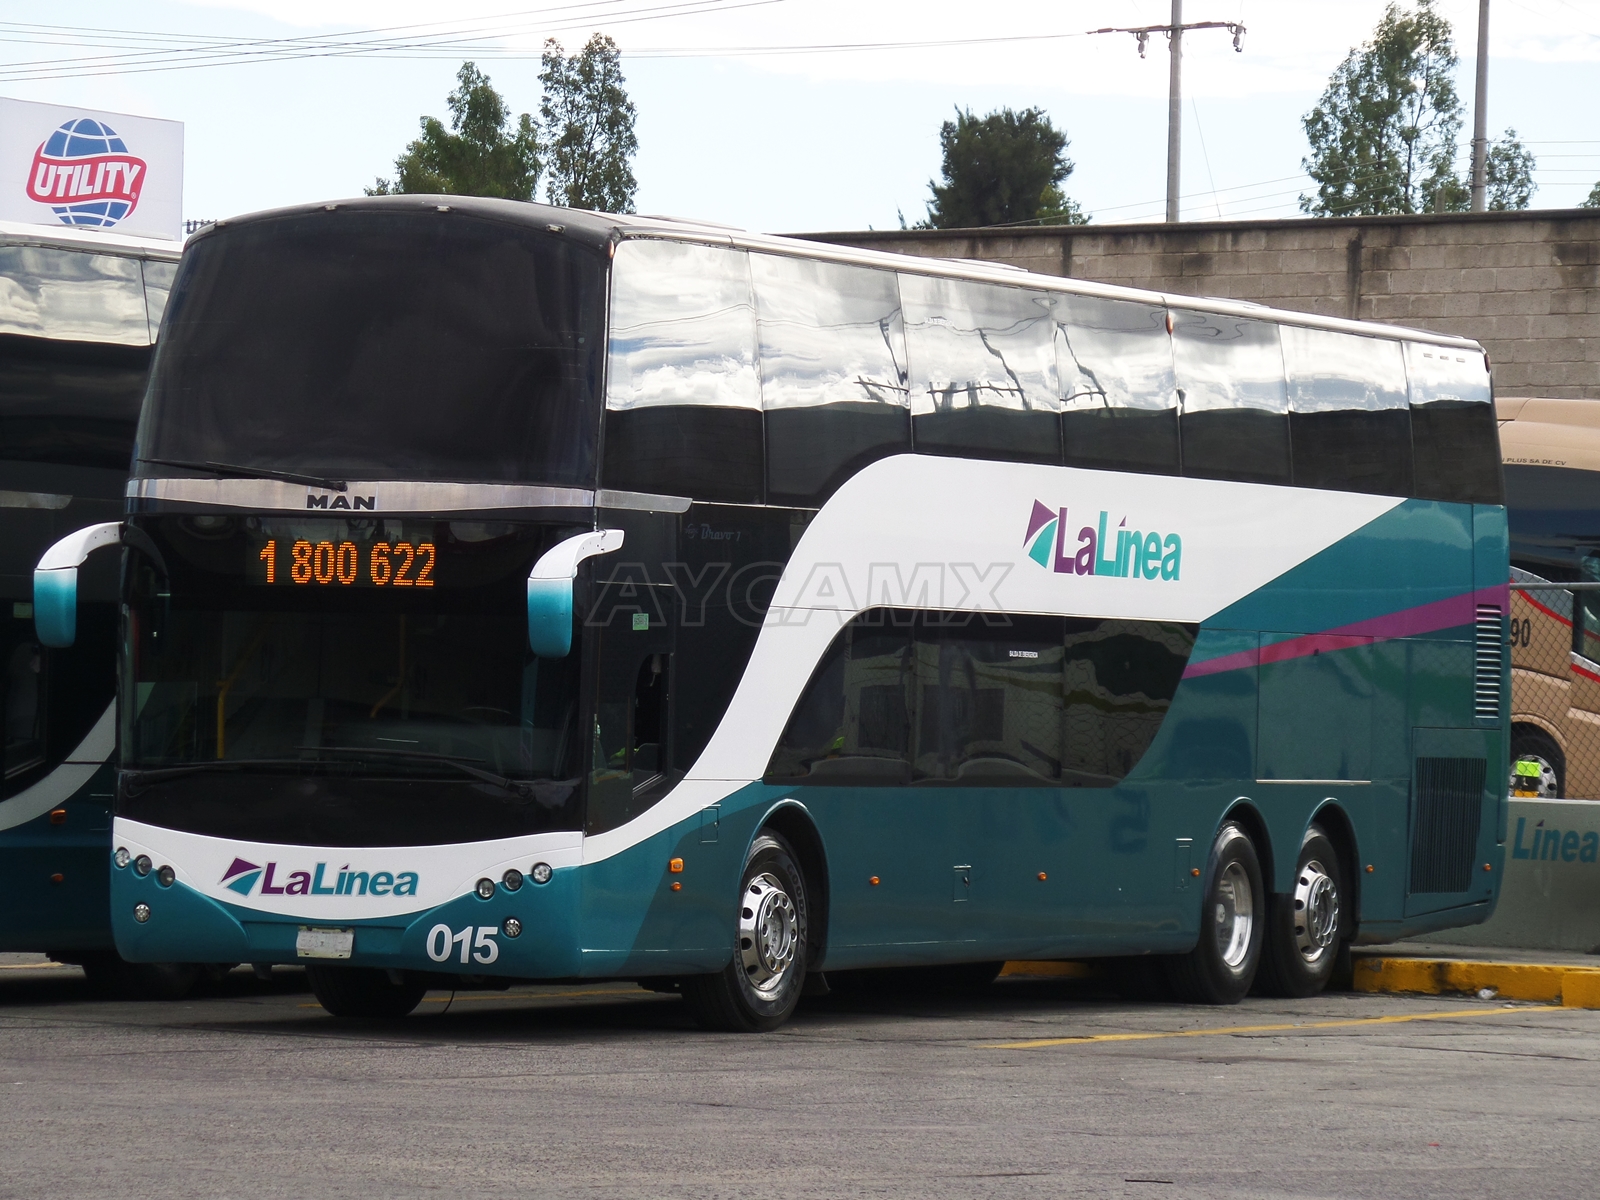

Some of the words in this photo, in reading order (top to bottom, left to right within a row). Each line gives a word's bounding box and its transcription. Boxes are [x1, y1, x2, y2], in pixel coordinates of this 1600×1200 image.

[34, 162, 141, 197] UTILITY
[306, 494, 374, 510] MAN
[701, 523, 735, 540] Bravo
[259, 540, 276, 584] 1
[291, 541, 358, 585] 800
[370, 542, 436, 586] 622
[1512, 817, 1600, 863] Línea
[426, 923, 499, 964] 015
